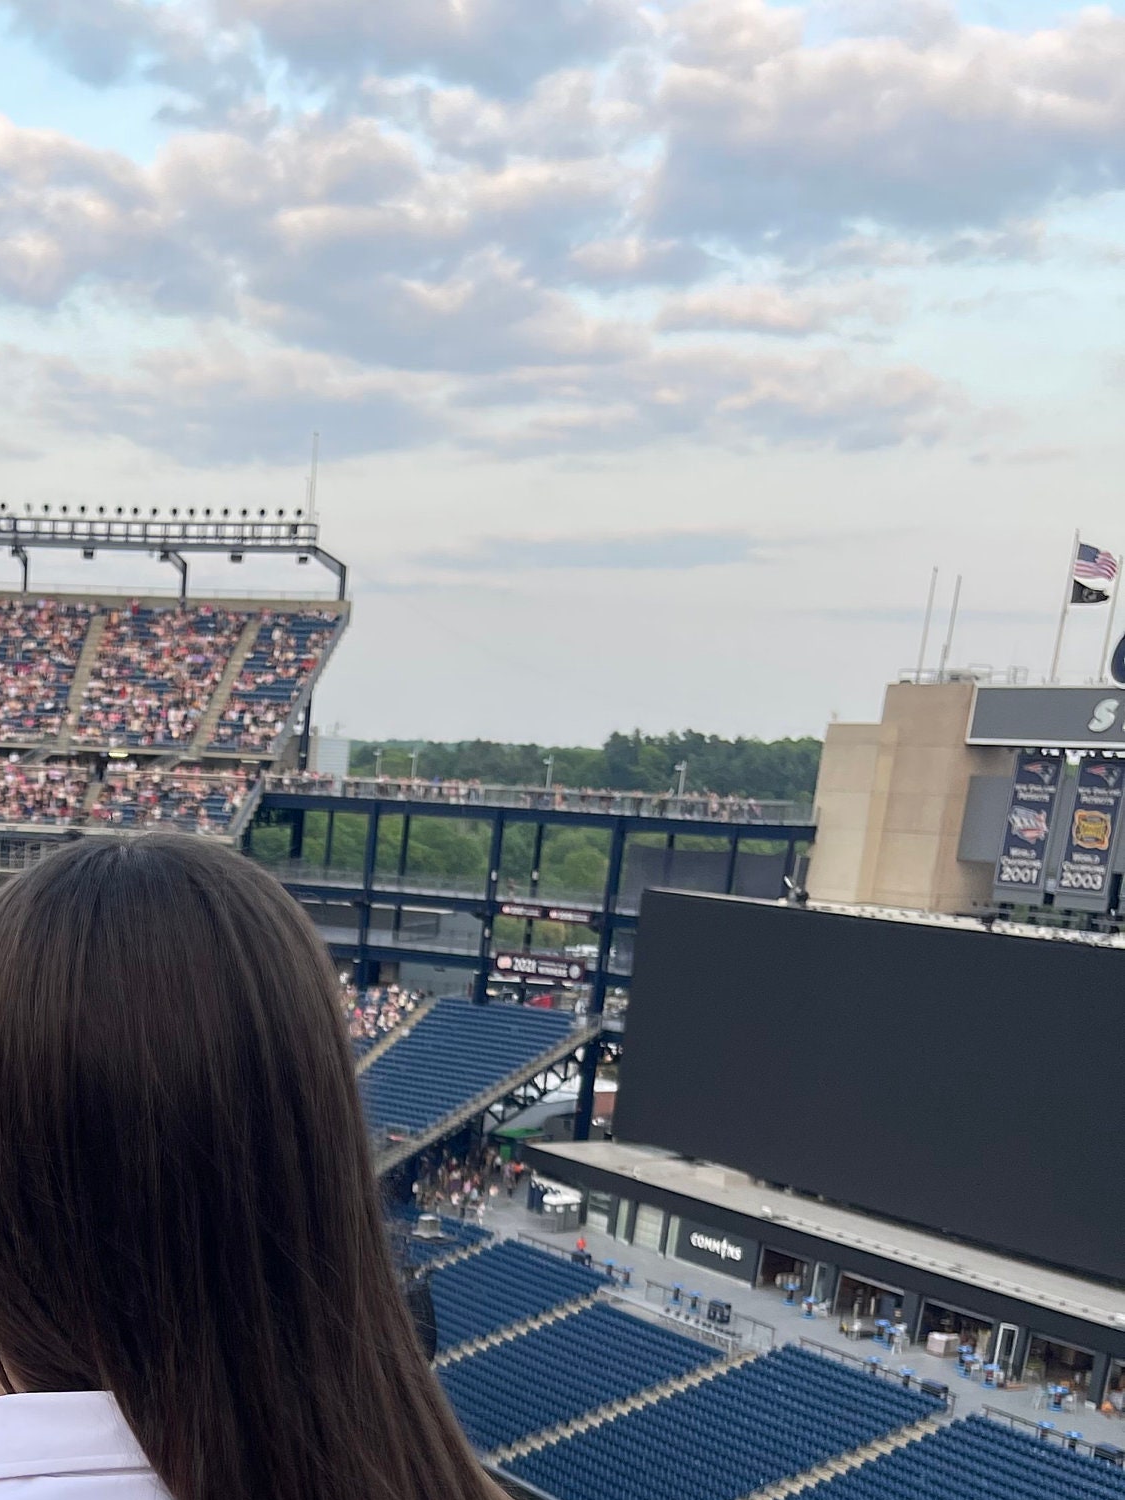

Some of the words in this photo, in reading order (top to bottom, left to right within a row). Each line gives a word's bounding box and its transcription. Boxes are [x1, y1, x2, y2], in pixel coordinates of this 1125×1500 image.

[1088, 699, 1125, 732] S
[1000, 866, 1038, 884] 2001
[1061, 872, 1103, 890] 2003
